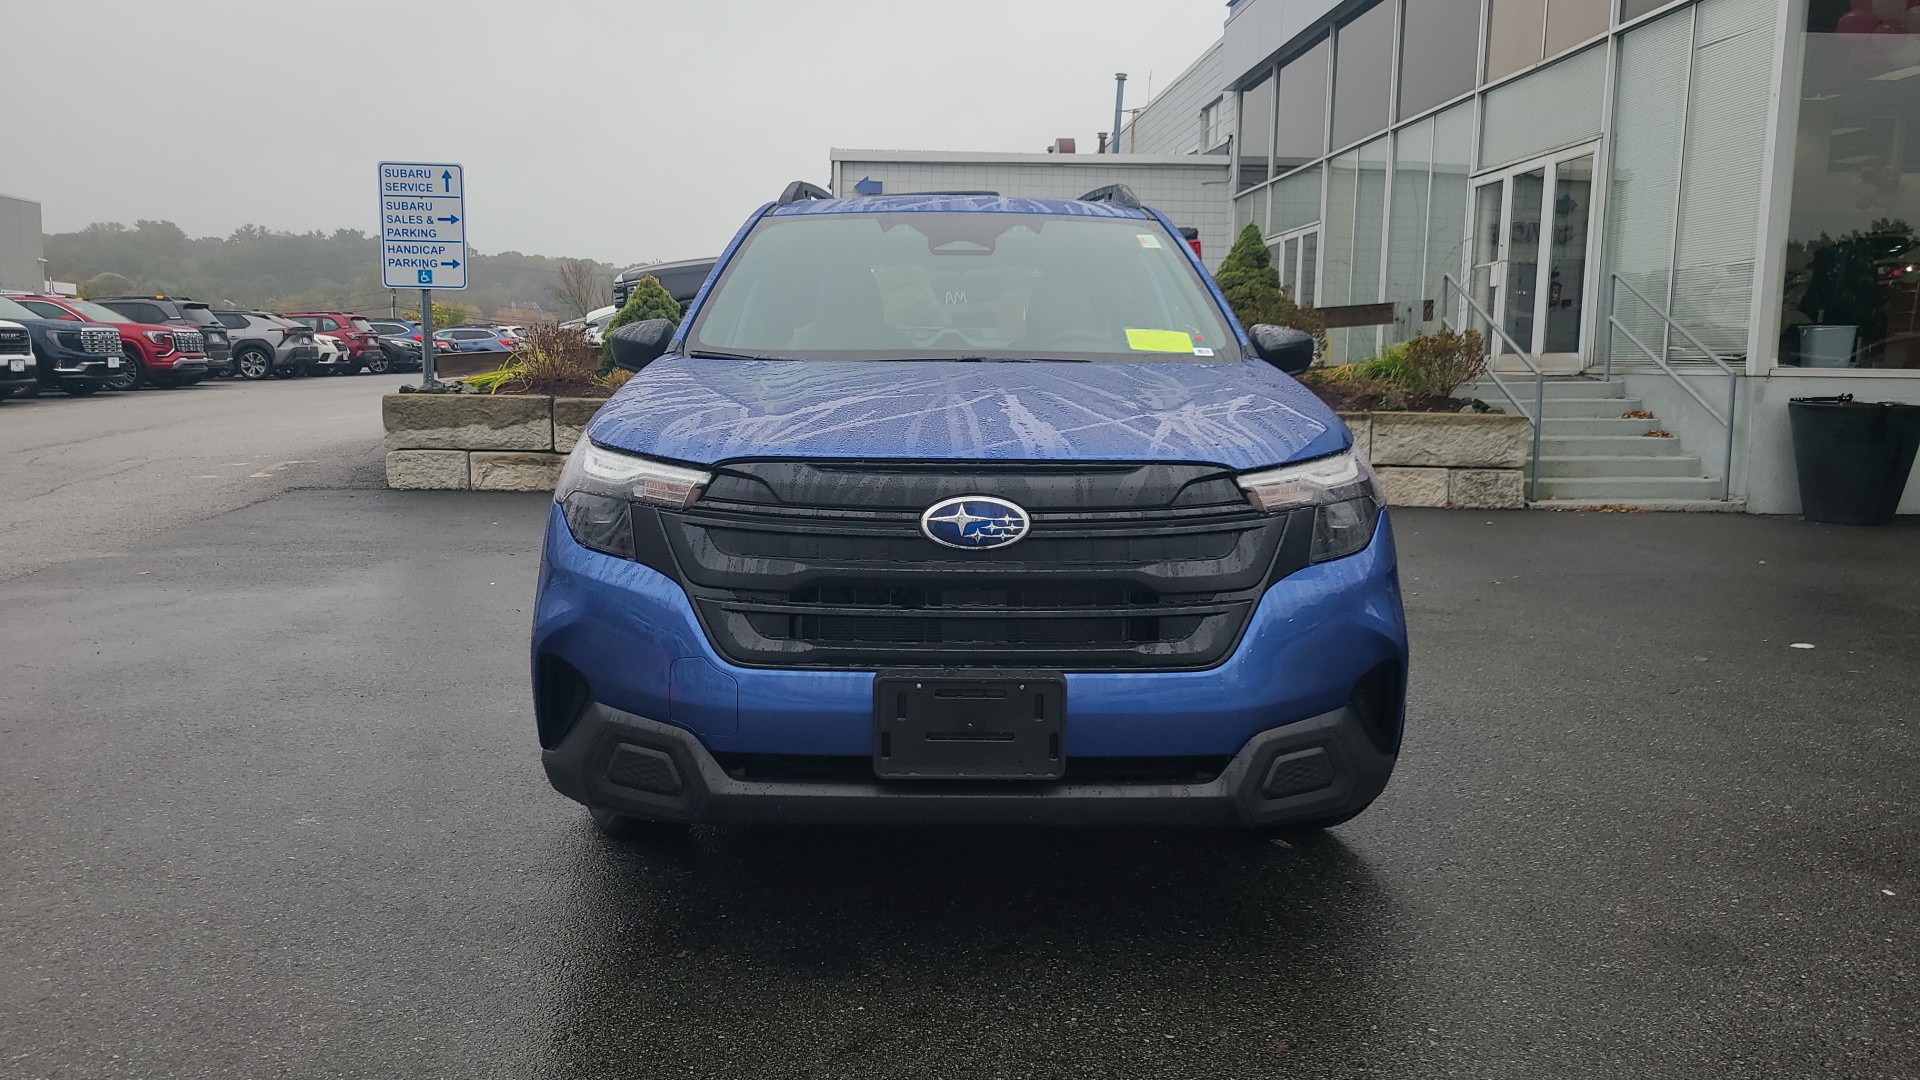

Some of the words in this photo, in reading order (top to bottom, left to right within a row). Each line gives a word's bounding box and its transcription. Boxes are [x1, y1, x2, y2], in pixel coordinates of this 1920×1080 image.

[384, 168, 432, 179] SUBARU
[385, 182, 433, 193] SERVICE
[386, 201, 433, 211] SUBARU
[386, 215, 423, 225] SALES
[426, 215, 434, 225] &
[387, 228, 437, 238] PARKING
[387, 245, 446, 255] HANDICAP
[388, 258, 438, 268] PARKING
